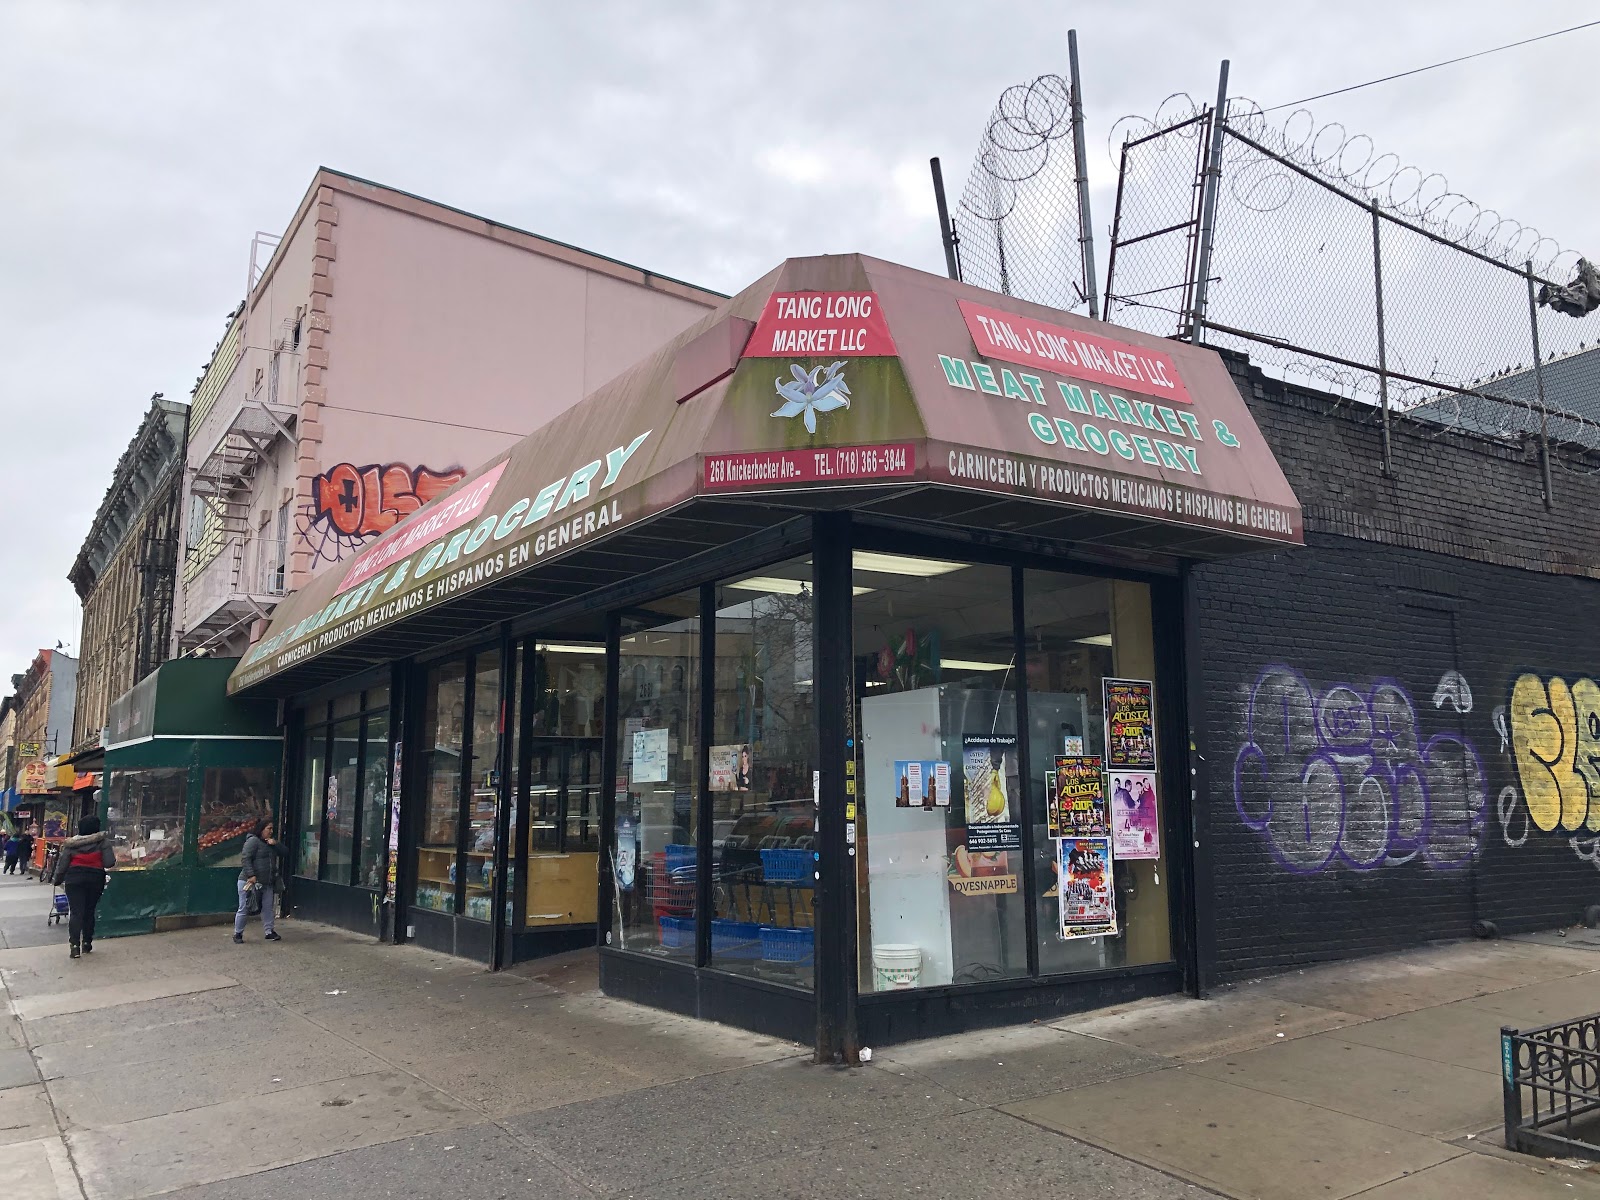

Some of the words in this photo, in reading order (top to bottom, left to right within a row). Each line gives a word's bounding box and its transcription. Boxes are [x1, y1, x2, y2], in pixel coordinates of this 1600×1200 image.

[772, 329, 838, 352] MARKET
[840, 328, 867, 351] LLC
[776, 297, 822, 319] TANG
[825, 296, 872, 319] LONG
[976, 314, 1032, 354] TANG
[1026, 327, 1078, 366] LONG
[1072, 340, 1146, 381] MARKET
[1140, 356, 1175, 389] LLC
[938, 353, 1047, 406] MEAT
[1057, 381, 1203, 441] MARKET
[1212, 419, 1241, 448] &
[710, 460, 725, 483] 268
[727, 458, 780, 482] Knickerbocker
[814, 453, 834, 476] TEL.
[836, 449, 859, 476] (718)
[1027, 412, 1202, 475] GROCERY
[948, 451, 1027, 488] CARNICERIA
[1029, 463, 1037, 489] Y
[1041, 465, 1109, 501] PRODUCTOS
[1111, 478, 1173, 512] MEXICANOS
[1176, 491, 1182, 514] E
[1185, 492, 1234, 524] HISPANOS
[1236, 503, 1248, 526] EN
[1250, 505, 1293, 535] GENERAL
[286, 572, 389, 645] MARKET
[384, 560, 411, 594] &
[414, 428, 653, 579] GROCERY
[346, 551, 380, 582] TANG
[372, 532, 408, 567] LONG
[402, 498, 462, 550] MARKET
[456, 482, 490, 518] LLC
[277, 641, 311, 668] CARNICERIA
[313, 639, 318, 652] Y
[319, 615, 364, 648] PRODUCTOS
[366, 589, 424, 628] MEXICANOS
[427, 585, 433, 601] E
[437, 553, 504, 598] HISPANOS
[509, 545, 529, 567] EN
[535, 499, 623, 556] GENERAL
[1112, 710, 1148, 723] ACOSTA
[1060, 782, 1100, 797] ACOSTA
